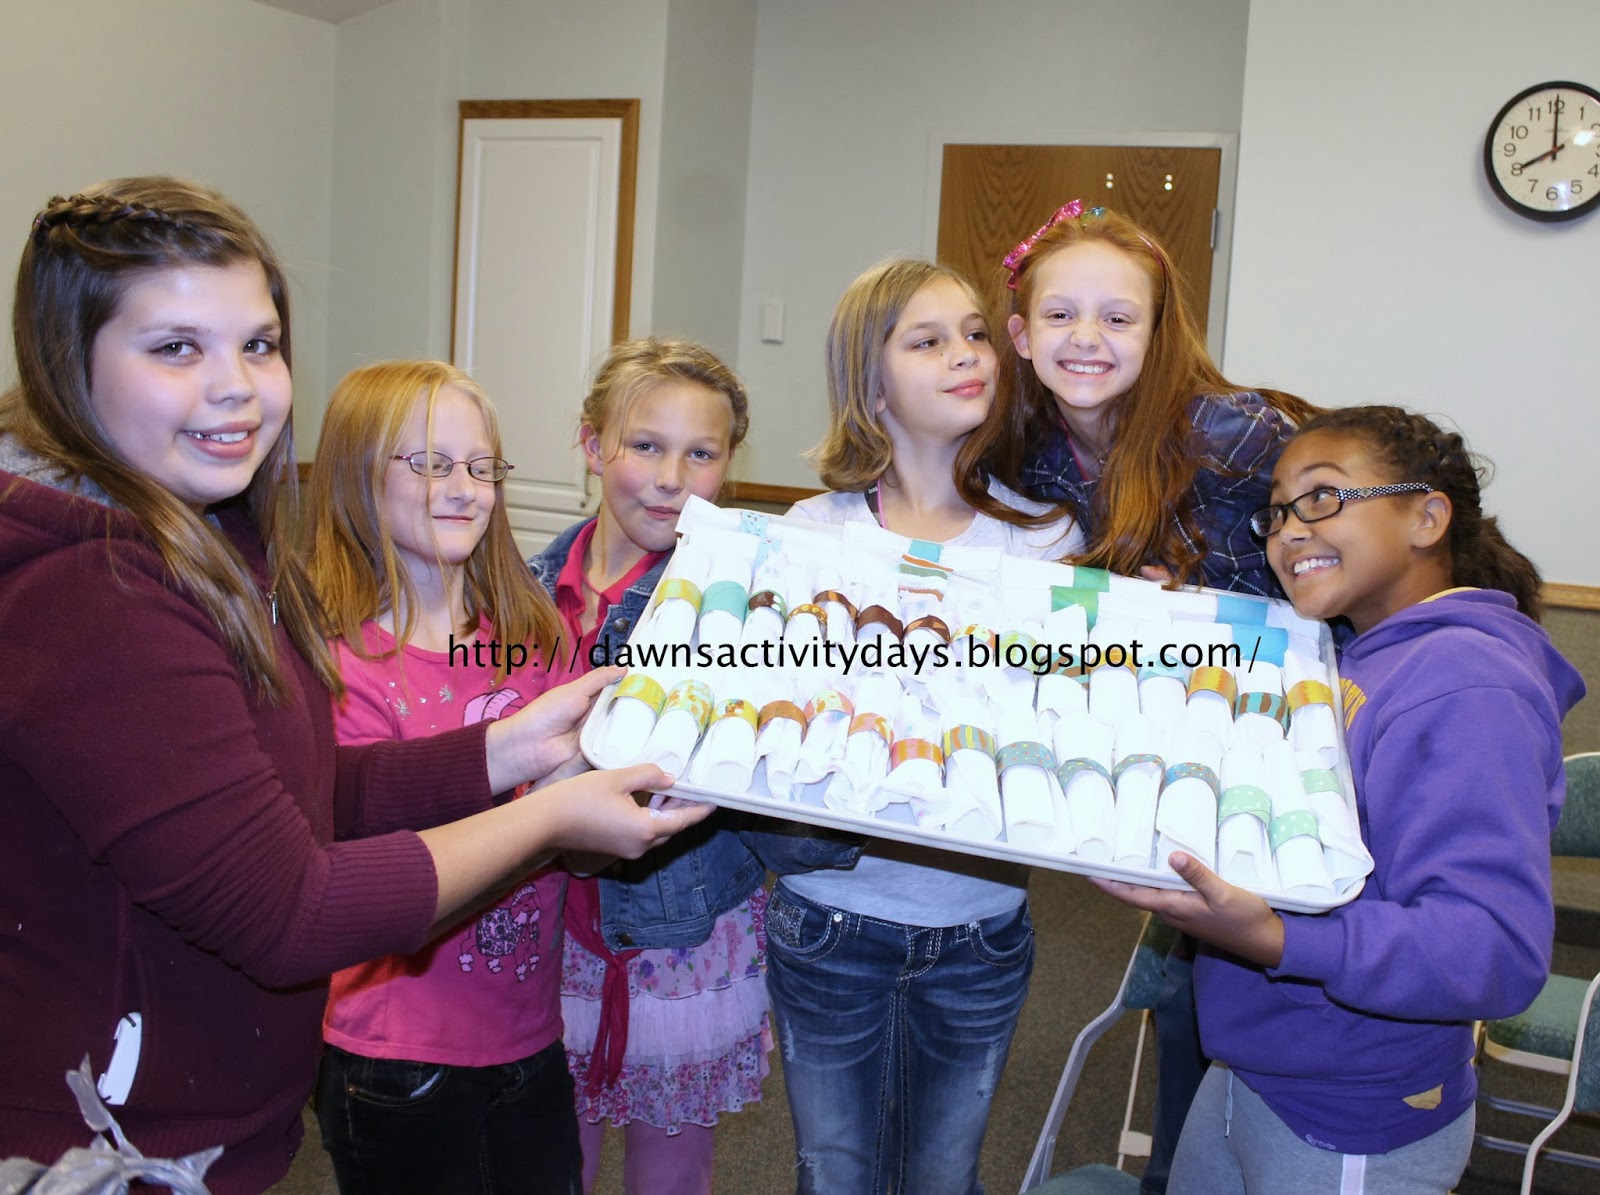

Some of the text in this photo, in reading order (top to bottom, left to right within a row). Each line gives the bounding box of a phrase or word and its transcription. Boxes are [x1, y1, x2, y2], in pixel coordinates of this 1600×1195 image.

[1528, 107, 1542, 121] 11
[1547, 99, 1566, 115] 12
[1579, 106, 1585, 121] 1
[1510, 125, 1529, 140] 10
[1503, 142, 1516, 157] 9
[1511, 162, 1523, 177] 8
[1587, 163, 1599, 178] 4
[1527, 179, 1539, 193] 7
[1545, 186, 1559, 201] 6
[1570, 180, 1583, 195] 5
